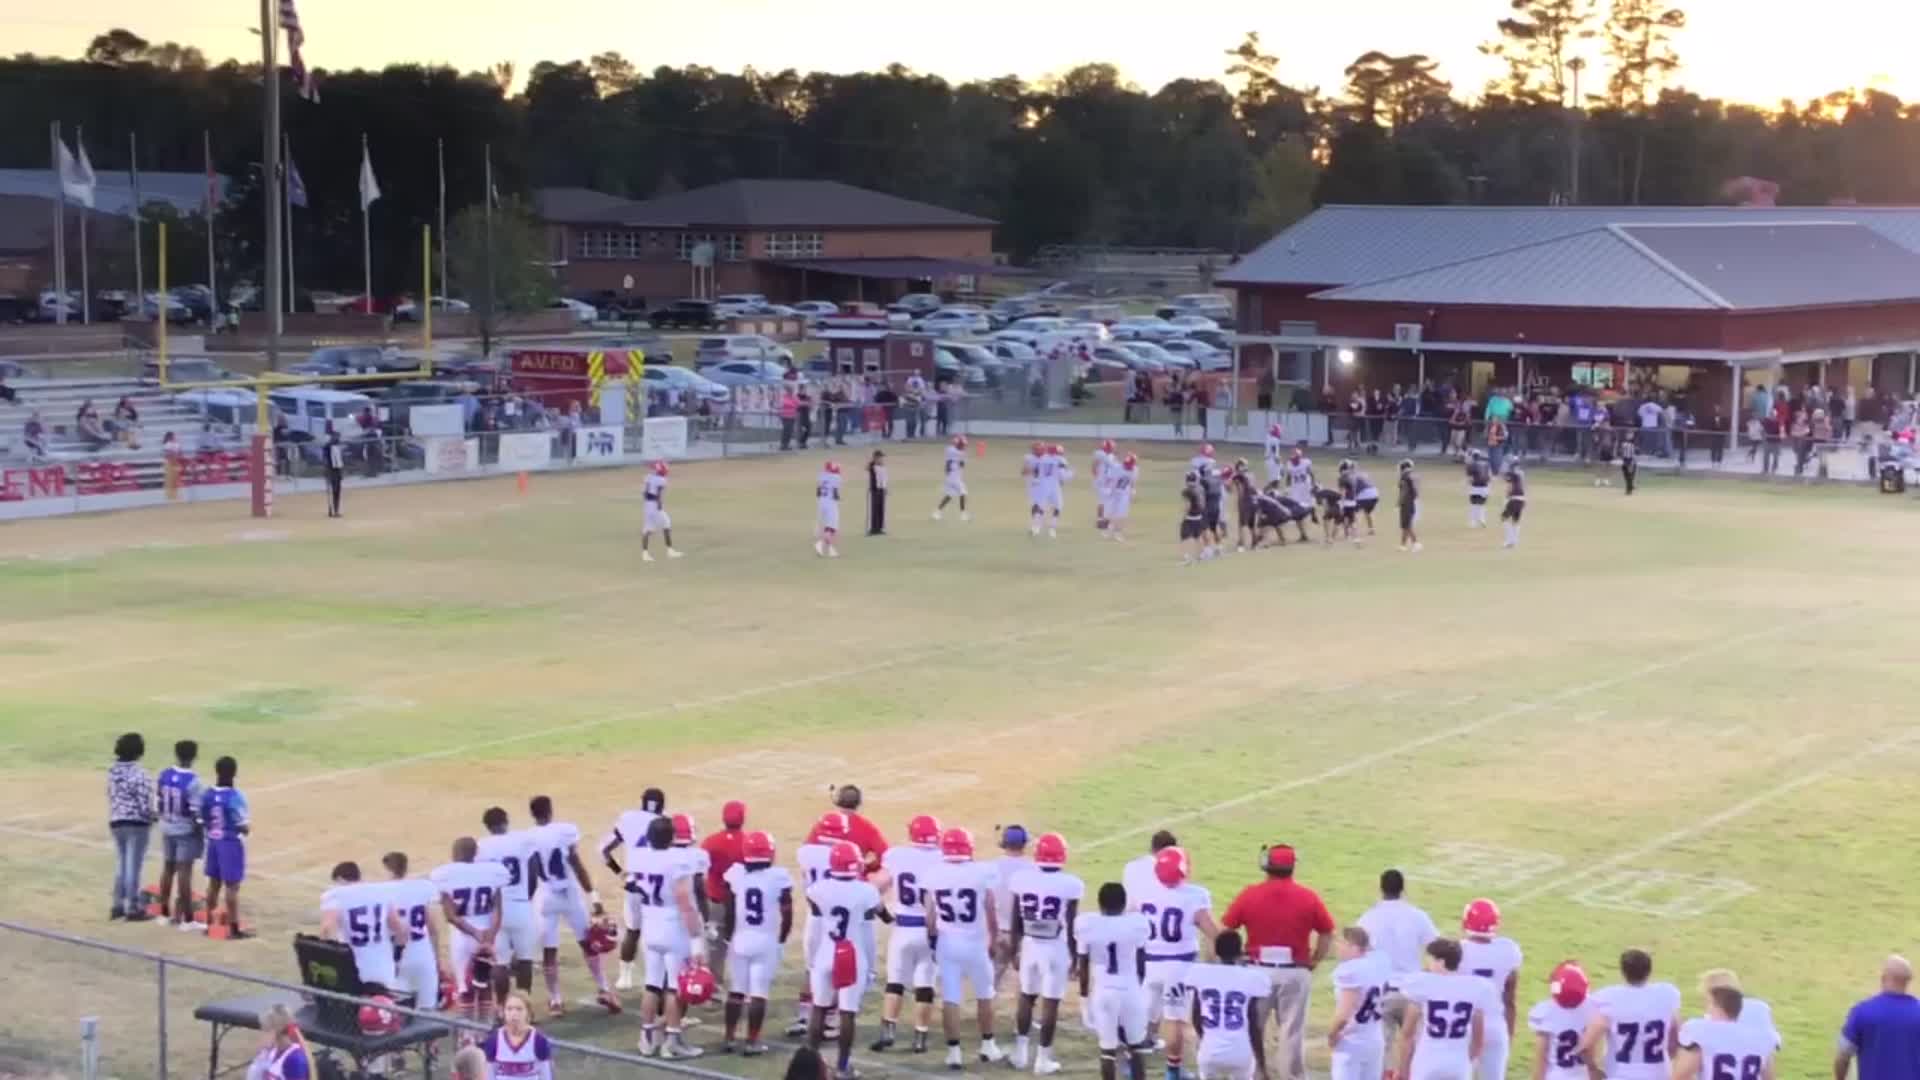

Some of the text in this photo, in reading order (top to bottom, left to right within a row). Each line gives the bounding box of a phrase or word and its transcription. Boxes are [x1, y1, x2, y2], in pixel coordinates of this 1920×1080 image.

[348, 903, 382, 947] 51
[745, 887, 764, 926] 9
[829, 906, 850, 942] 3
[935, 888, 977, 923] 53
[1106, 941, 1119, 975] 1
[1200, 988, 1247, 1031] 36
[1426, 1000, 1474, 1040] 52
[1615, 1020, 1666, 1064] 72
